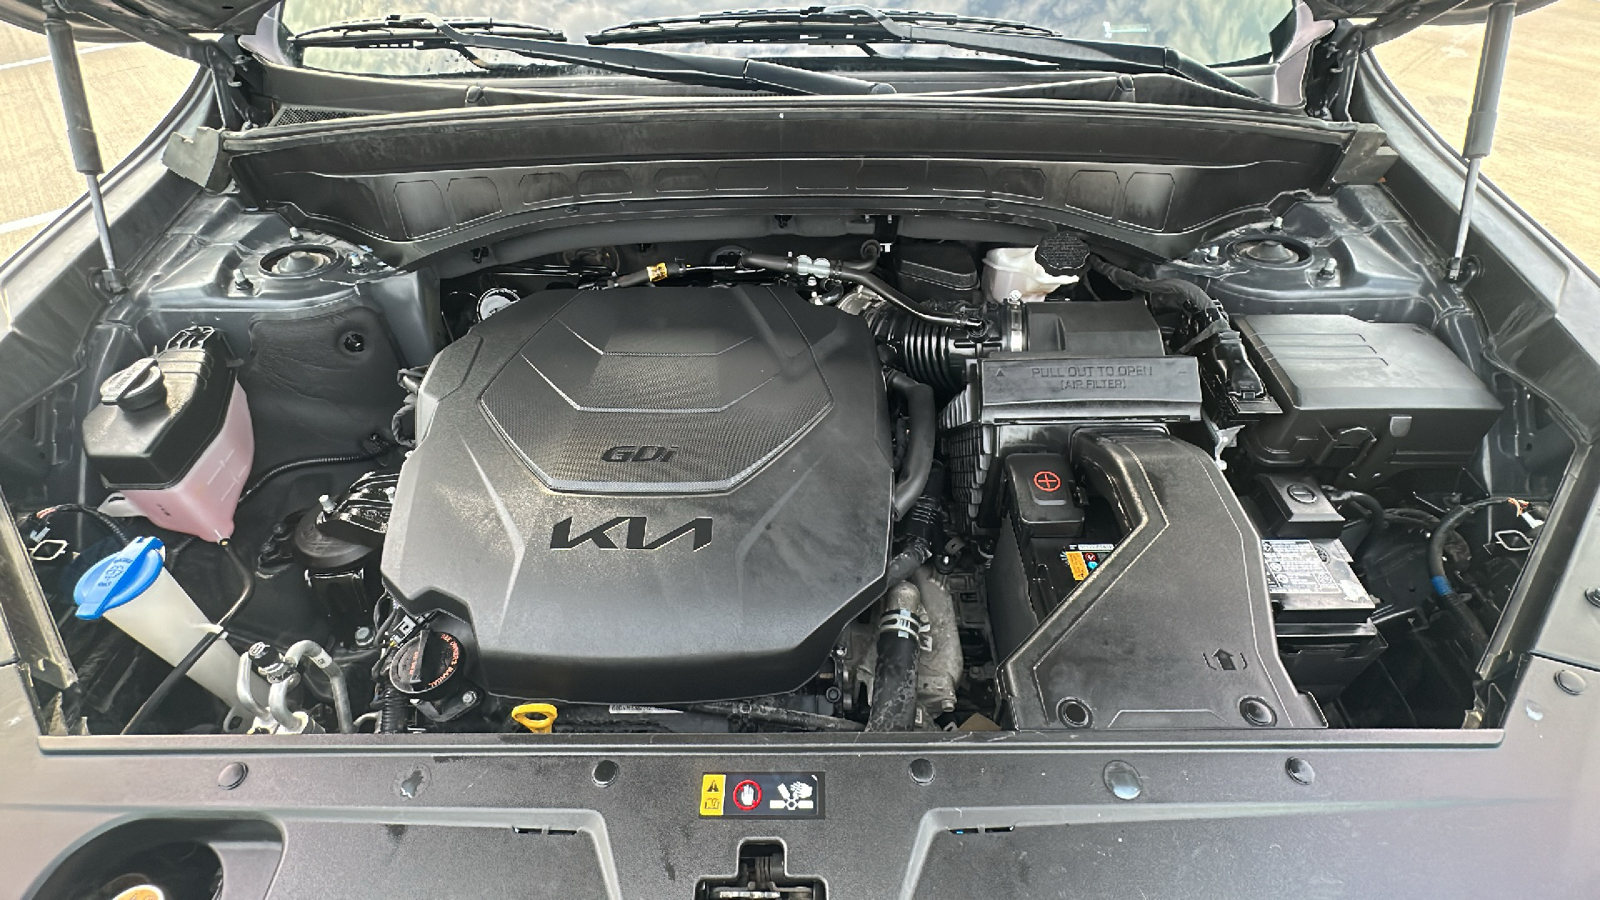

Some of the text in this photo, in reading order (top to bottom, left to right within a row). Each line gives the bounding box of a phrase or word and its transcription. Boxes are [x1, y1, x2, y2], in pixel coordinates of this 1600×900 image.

[1031, 366, 1153, 378] PULL OUT TO OPEN
[601, 446, 679, 462] GDi
